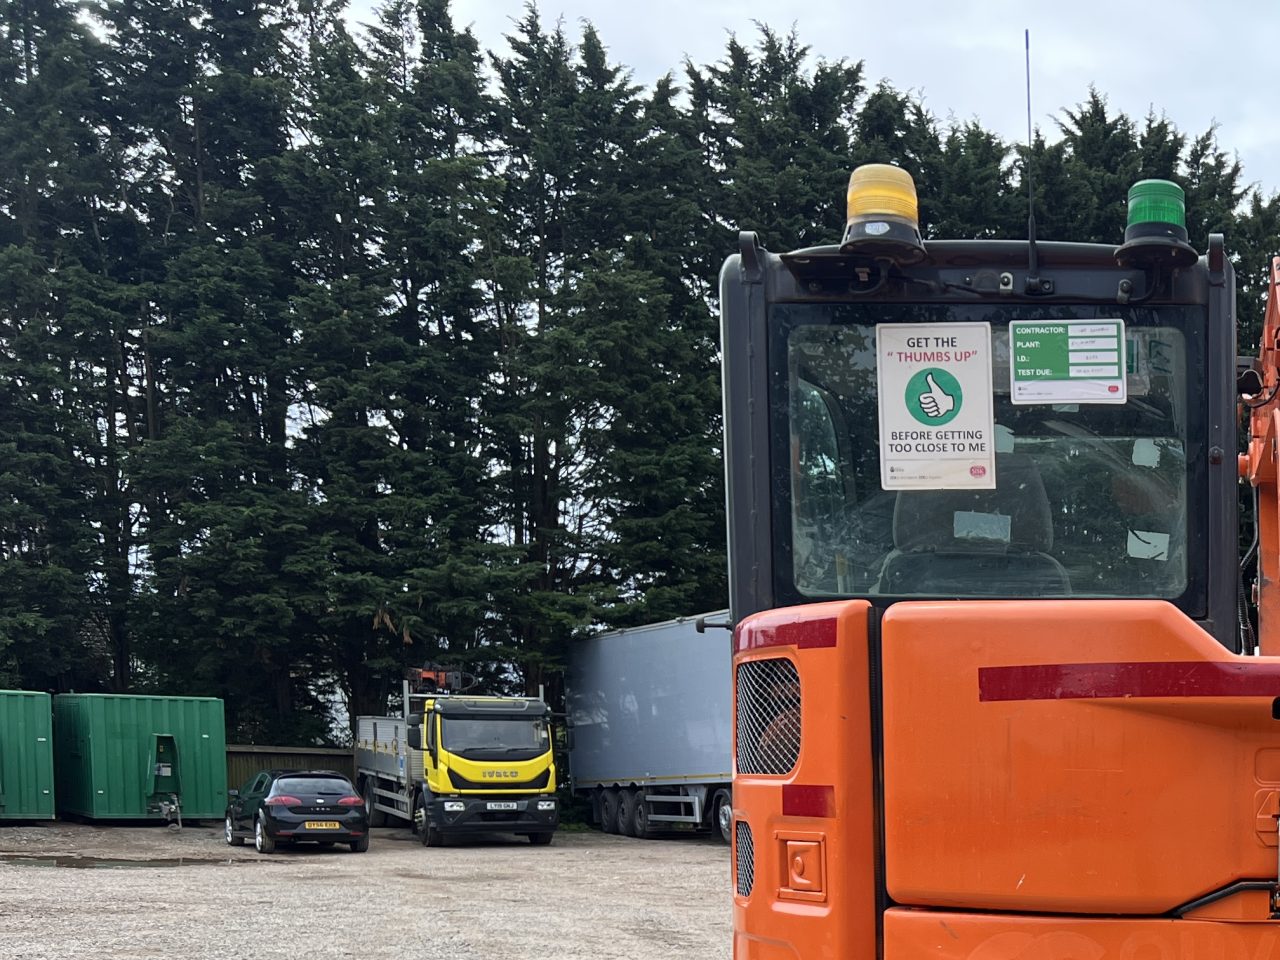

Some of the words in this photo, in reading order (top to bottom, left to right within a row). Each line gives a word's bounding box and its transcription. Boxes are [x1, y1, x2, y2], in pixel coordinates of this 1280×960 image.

[1016, 326, 1065, 334] CONTRACTOR:
[907, 337, 930, 348] GET
[934, 337, 957, 348] THE
[891, 430, 932, 441] BEFORE
[935, 430, 983, 440] GETTING
[888, 443, 912, 453] TOO
[915, 442, 948, 453] CLOSE
[951, 442, 965, 452] TO
[968, 442, 986, 452] ME
[482, 770, 519, 778] IVECO
